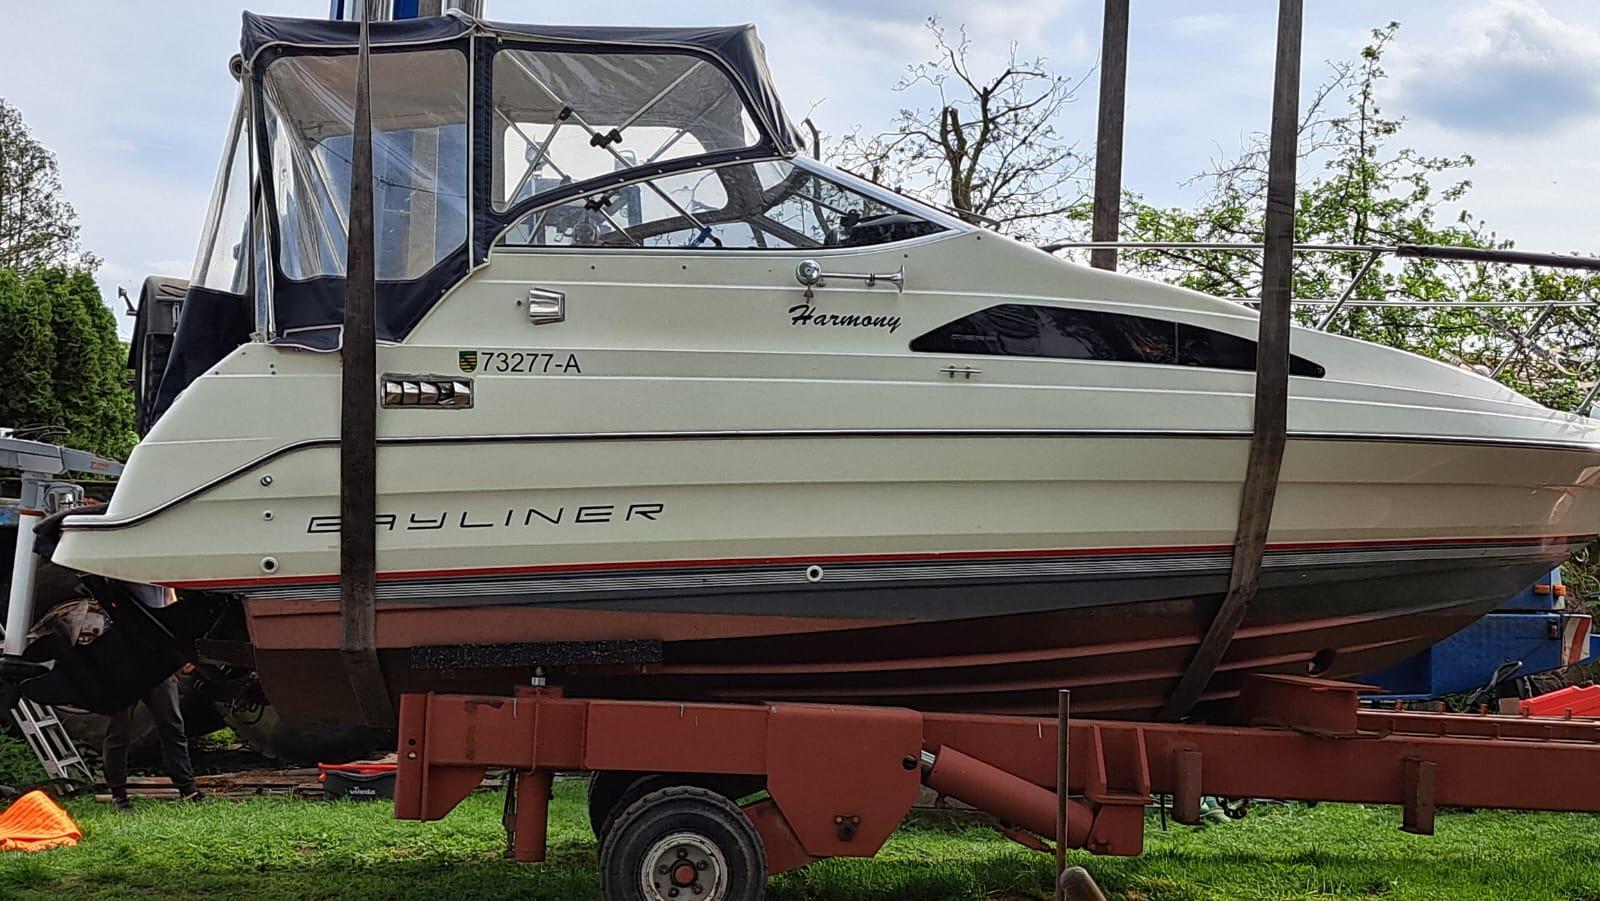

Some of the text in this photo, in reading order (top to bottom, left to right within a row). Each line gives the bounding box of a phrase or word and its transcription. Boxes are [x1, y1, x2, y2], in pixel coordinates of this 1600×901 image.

[788, 304, 901, 333] Harmony
[481, 352, 581, 373] 73277-A
[349, 786, 376, 795] vileda
